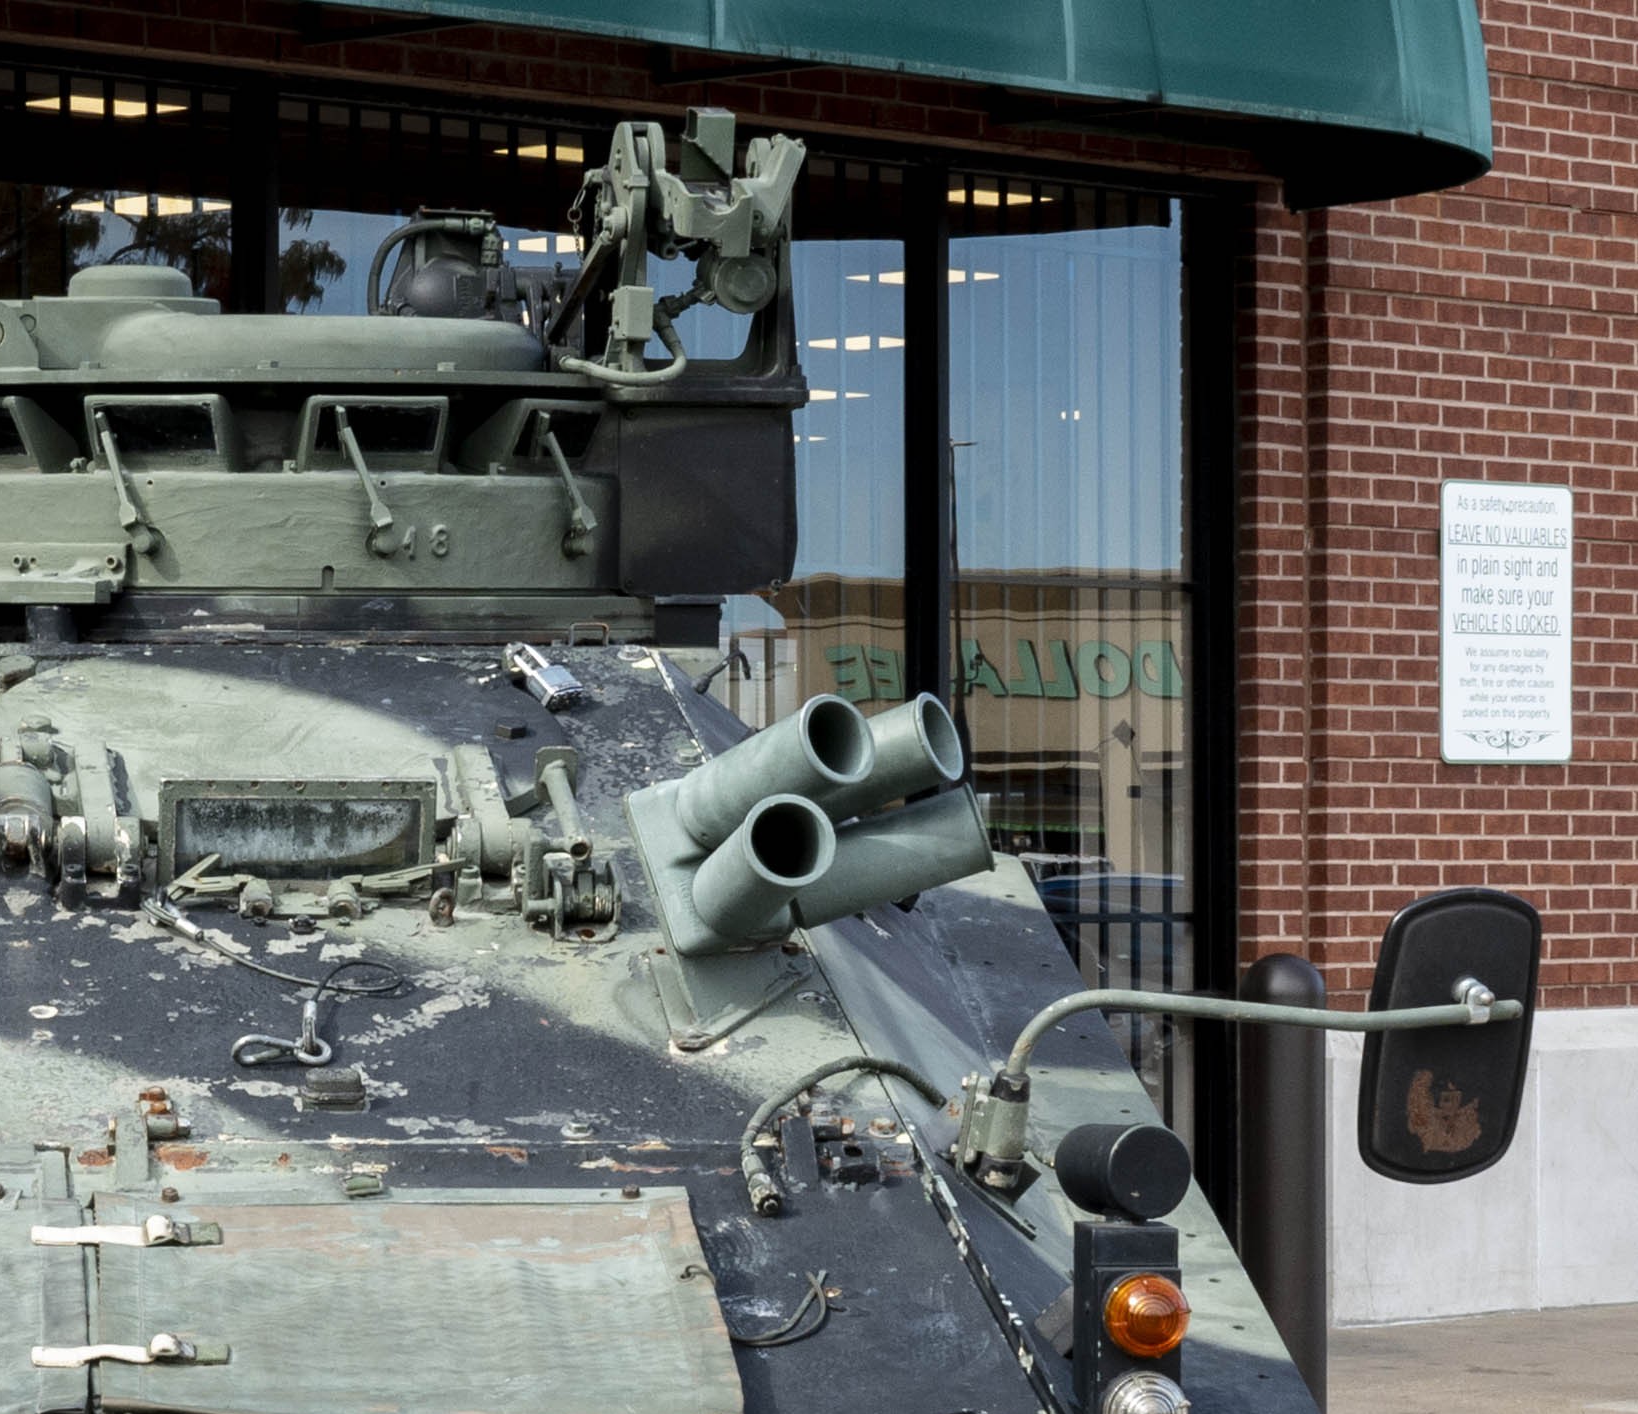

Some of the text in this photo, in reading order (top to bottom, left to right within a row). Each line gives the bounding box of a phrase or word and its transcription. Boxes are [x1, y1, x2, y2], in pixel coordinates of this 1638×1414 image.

[1480, 496, 1505, 514] safety
[1448, 523, 1567, 546] LEAVE NO VALUABLES
[1457, 553, 1558, 580] in plain sight and
[1462, 584, 1554, 610] make sure your
[1452, 613, 1561, 634] VEHICLE IS LOCKED.
